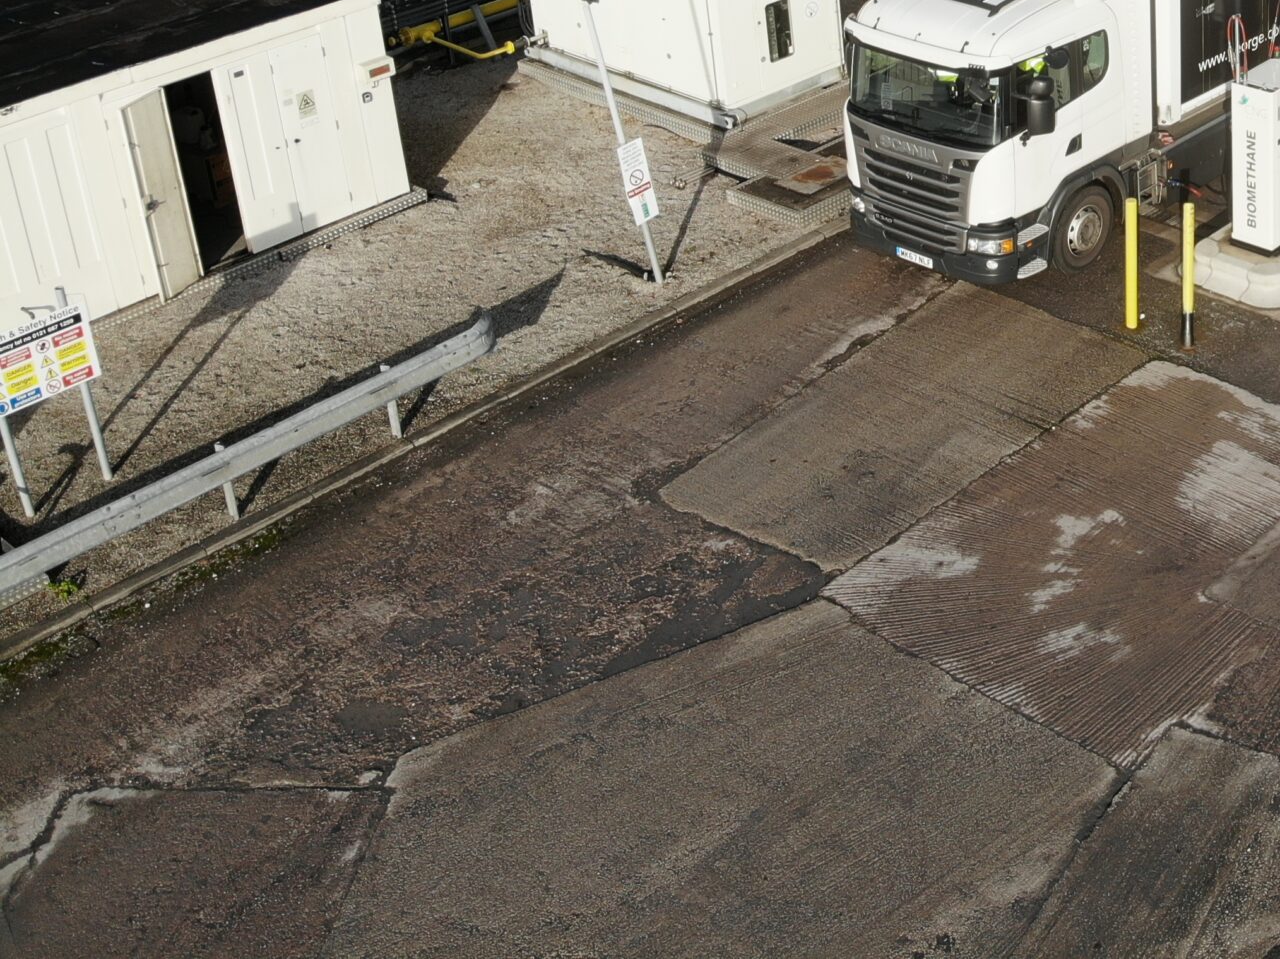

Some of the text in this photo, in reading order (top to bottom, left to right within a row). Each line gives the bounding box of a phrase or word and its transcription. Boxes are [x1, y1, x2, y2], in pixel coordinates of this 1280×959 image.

[880, 134, 939, 163] SCANIA
[1246, 129, 1256, 228] BIOMETHANE
[9, 330, 15, 338] &
[18, 319, 47, 334] Safety
[49, 306, 79, 321] Notice
[32, 329, 46, 339] 0121
